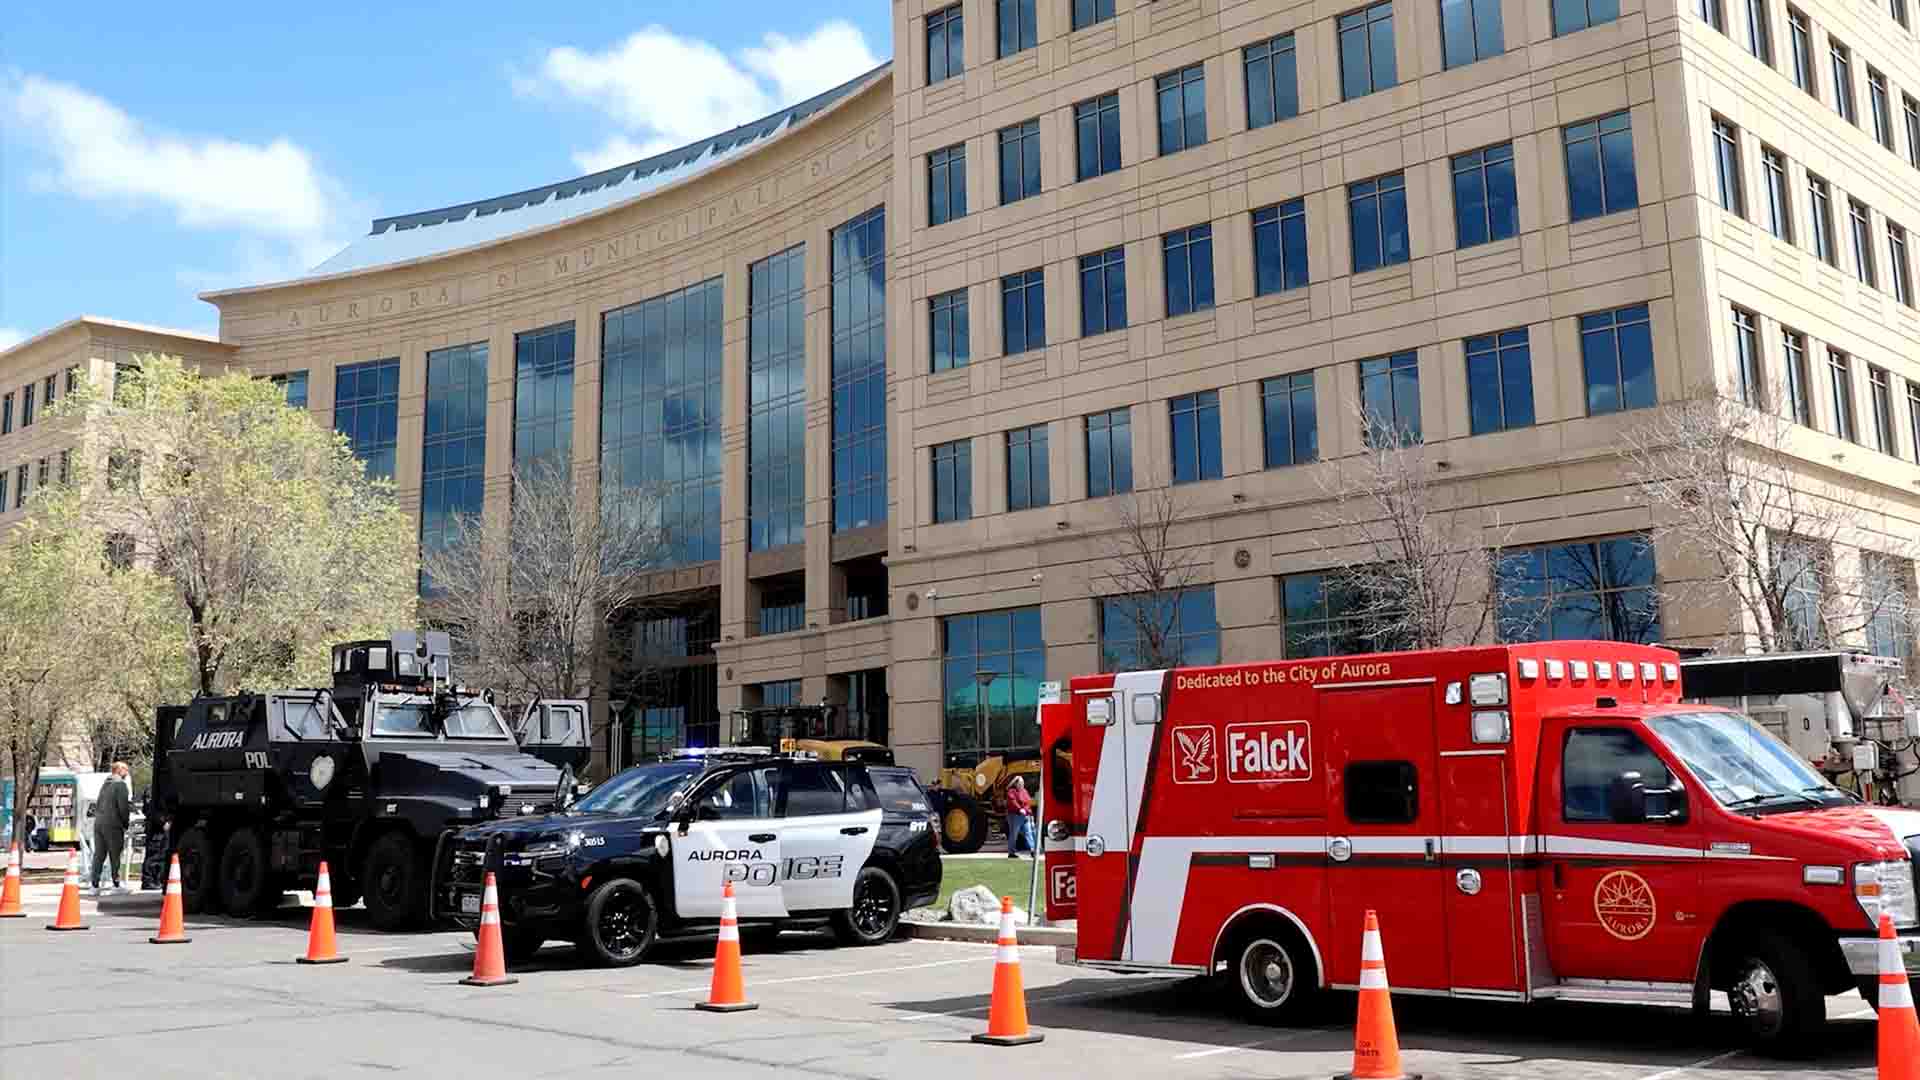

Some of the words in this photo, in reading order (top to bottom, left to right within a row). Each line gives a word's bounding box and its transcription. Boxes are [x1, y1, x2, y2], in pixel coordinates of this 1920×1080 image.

[287, 287, 450, 328] AURORA
[554, 188, 765, 274] MUNICIPAL
[1176, 670, 1241, 690] Dedicated
[1245, 673, 1260, 685] to
[1263, 668, 1286, 684] the
[1289, 665, 1318, 683] City
[1321, 662, 1337, 680] of
[1341, 662, 1391, 678] Aurora
[191, 731, 245, 750] AURORA
[1229, 729, 1308, 774] Falck
[688, 849, 763, 862] AURORA
[1604, 915, 1649, 935] AURORA
